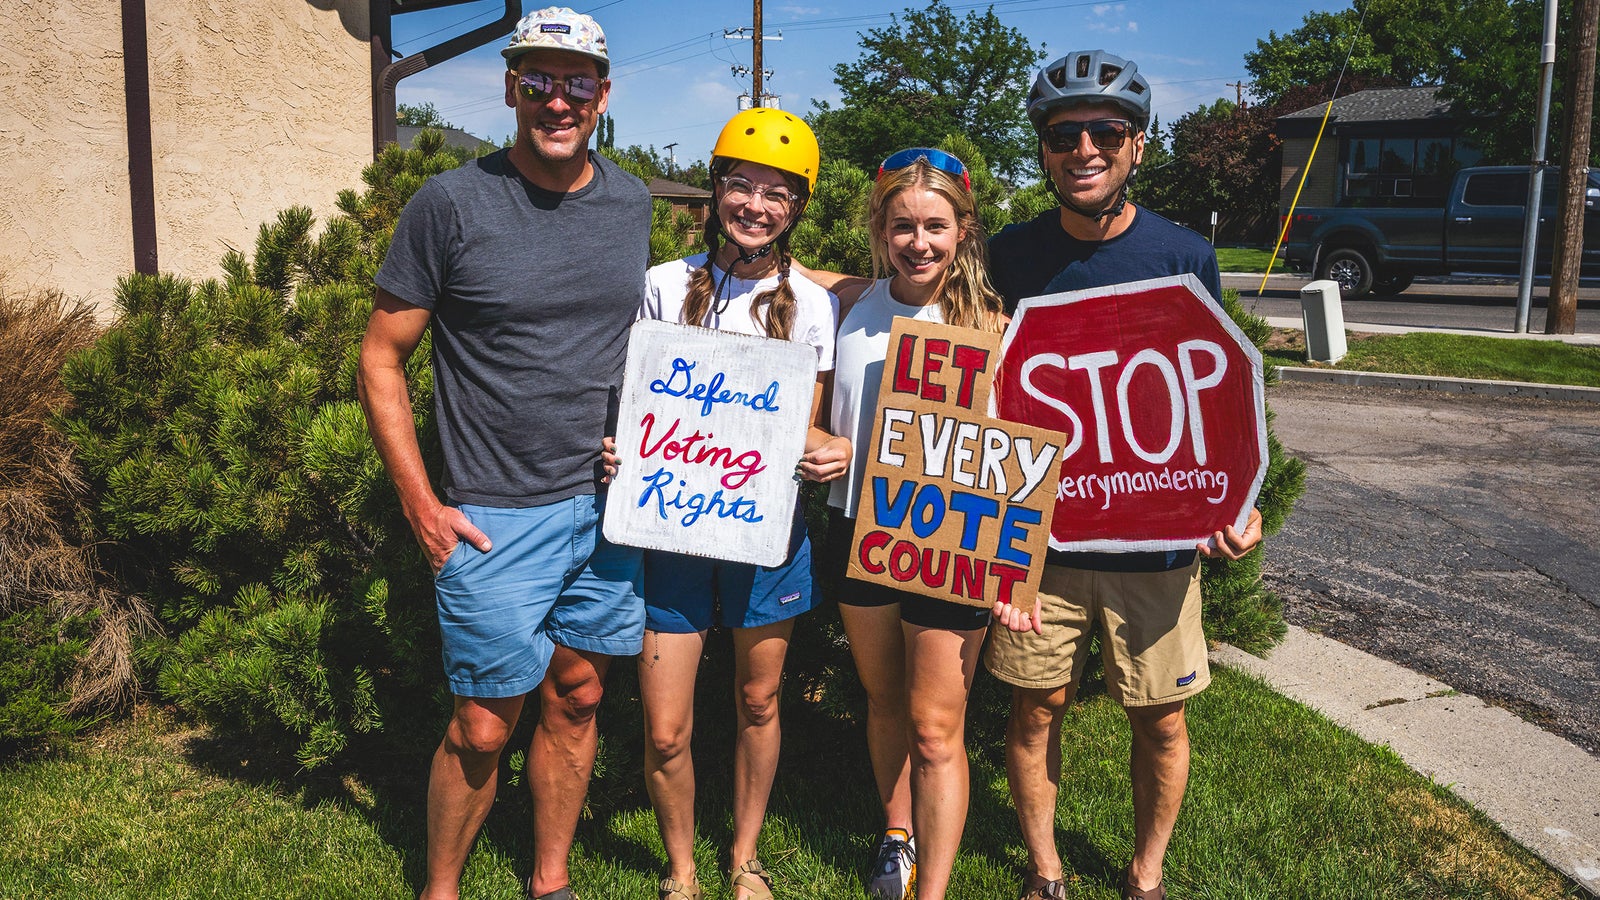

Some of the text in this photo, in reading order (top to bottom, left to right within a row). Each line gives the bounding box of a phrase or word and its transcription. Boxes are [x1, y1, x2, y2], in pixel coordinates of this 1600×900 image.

[650, 357, 780, 417] Defend
[892, 333, 990, 409] LET
[1020, 339, 1228, 466] STOP
[639, 412, 768, 490] Voting
[877, 407, 1059, 503] EVERY
[637, 467, 764, 528] Rights
[872, 476, 1042, 566] VOTE
[859, 530, 1030, 605] COUNT
